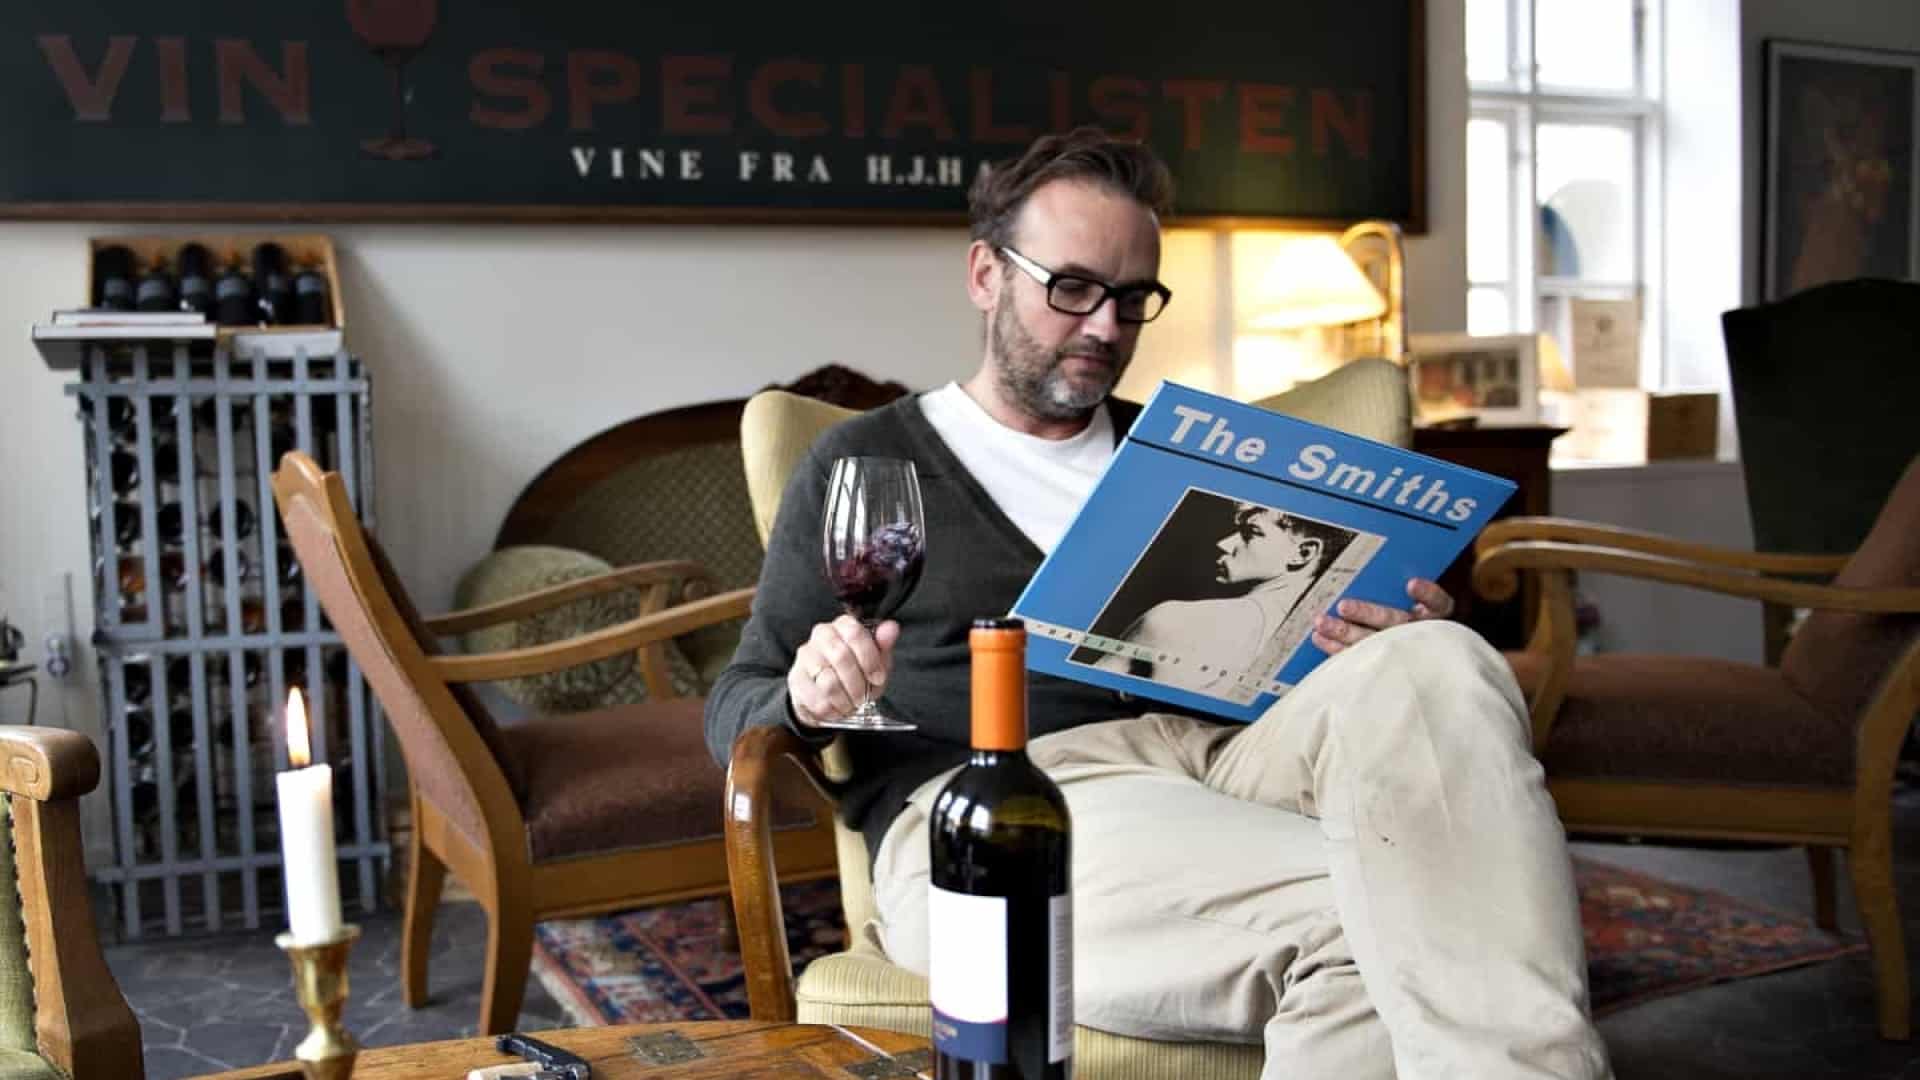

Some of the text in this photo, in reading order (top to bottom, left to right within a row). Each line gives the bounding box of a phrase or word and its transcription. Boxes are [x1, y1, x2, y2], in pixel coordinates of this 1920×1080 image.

[36, 33, 1374, 160] VIN SPECIALISTEN
[571, 147, 704, 180] VINE
[738, 151, 832, 182] FRA
[1169, 403, 1477, 522] The Smiths
